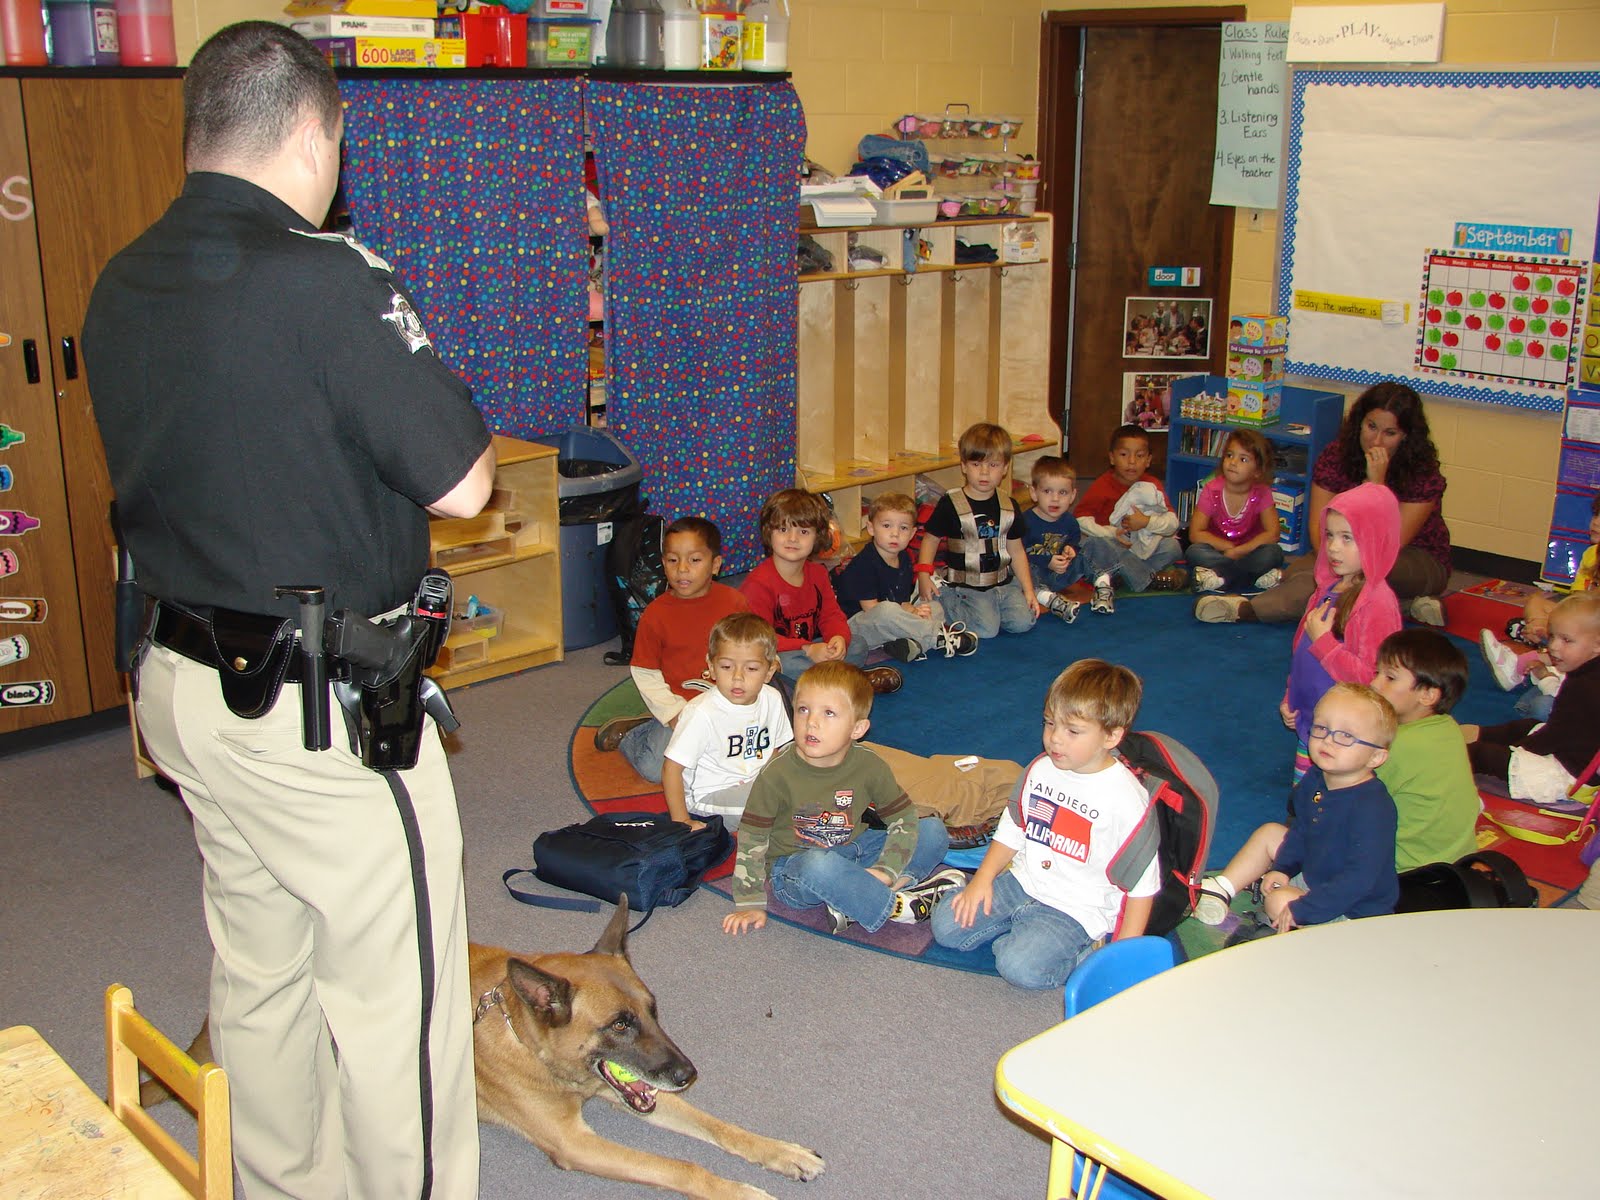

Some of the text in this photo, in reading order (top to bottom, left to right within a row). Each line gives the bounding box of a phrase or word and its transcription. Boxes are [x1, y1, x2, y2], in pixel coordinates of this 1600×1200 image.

[341, 21, 368, 29] PRANG
[1224, 24, 1258, 39] Class
[1341, 22, 1380, 38] PLAY
[361, 48, 389, 64] 600
[1229, 47, 1262, 66] Walking
[1267, 46, 1284, 61] feet
[1231, 69, 1264, 84] Gentle
[1247, 83, 1280, 95] hands
[1231, 109, 1278, 128] Listening
[1243, 125, 1267, 139] Ears
[1226, 152, 1246, 170] Eyes
[1248, 154, 1258, 164] on
[1261, 153, 1276, 164] the
[1241, 166, 1273, 178] teacher
[1467, 226, 1556, 247] September
[1155, 270, 1174, 280] door
[1296, 294, 1377, 316] Today the weather is
[7, 689, 36, 699] black
[1057, 792, 1099, 819] DIEGO
[1026, 821, 1086, 860] ALIFORNIA
